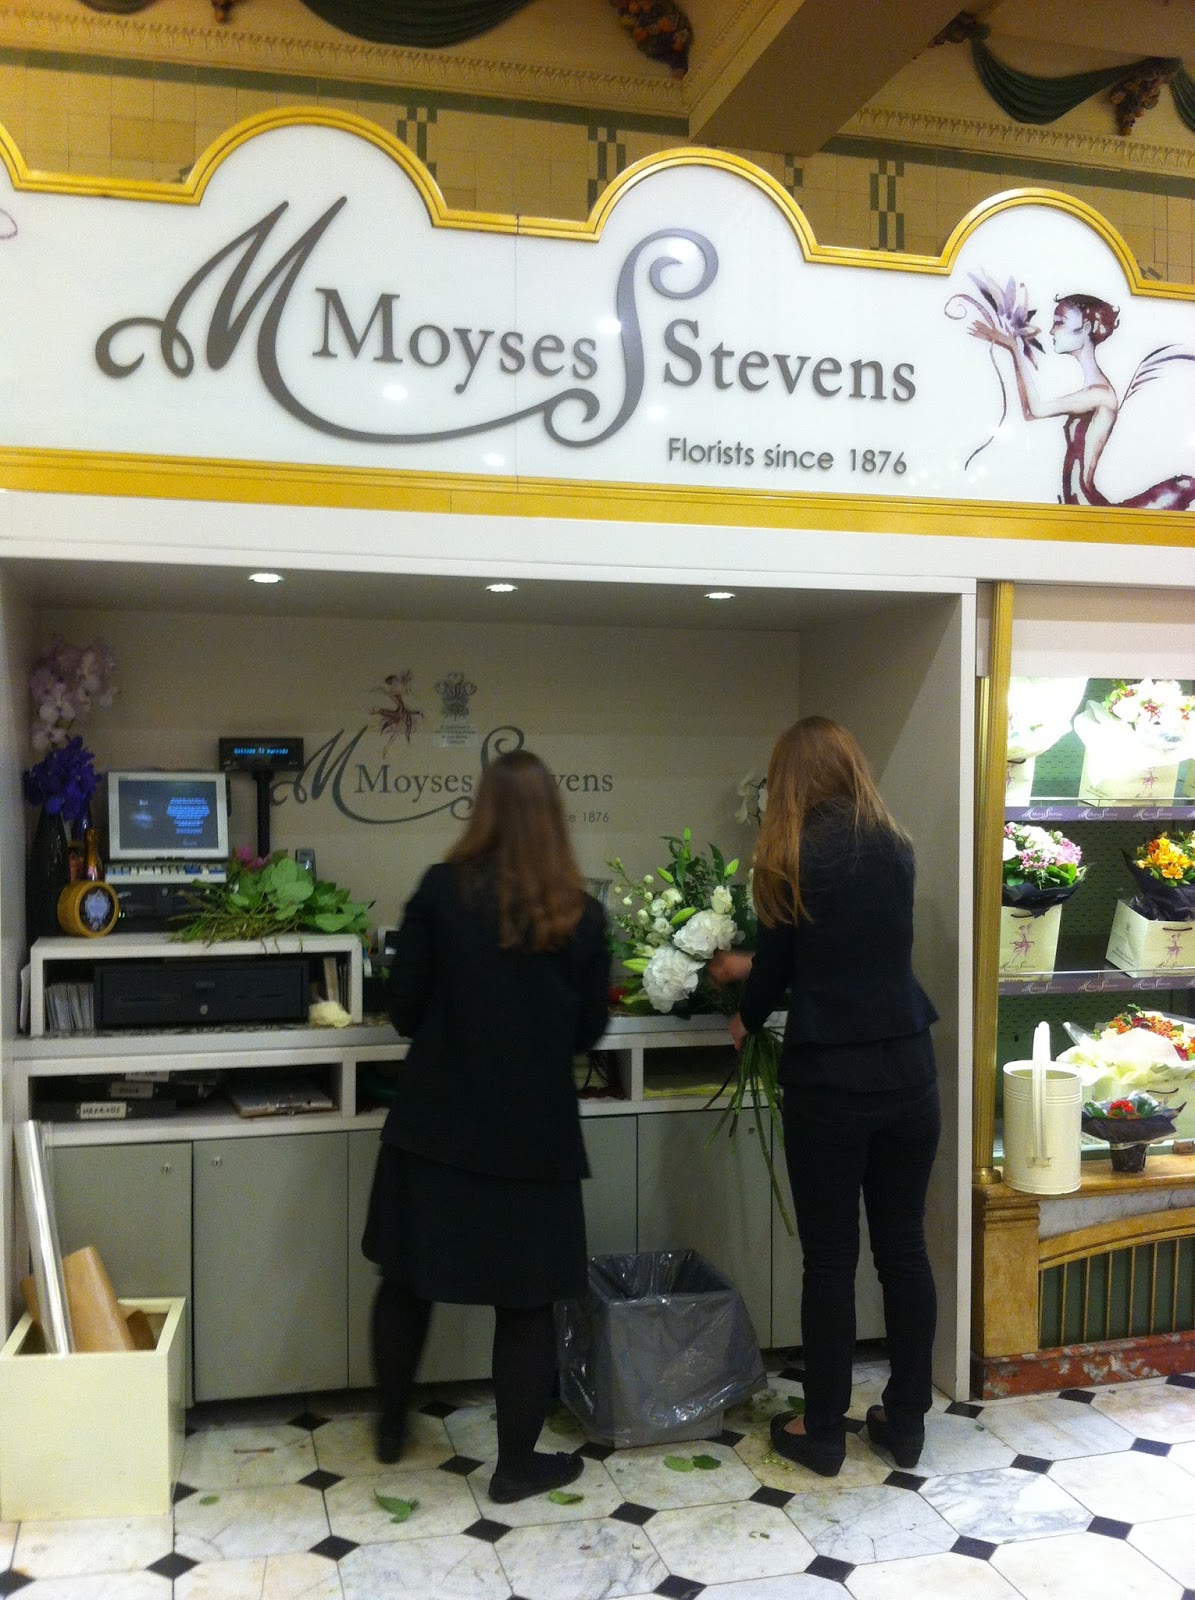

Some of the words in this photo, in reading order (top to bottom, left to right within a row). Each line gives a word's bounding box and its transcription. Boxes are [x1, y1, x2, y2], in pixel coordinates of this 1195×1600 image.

[311, 287, 598, 395] Moyses
[663, 317, 917, 404] Stevens
[667, 437, 756, 467] Florists
[764, 447, 835, 472] since
[849, 447, 908, 476] 1876
[354, 763, 474, 804] Moyses
[582, 811, 610, 823] 1876
